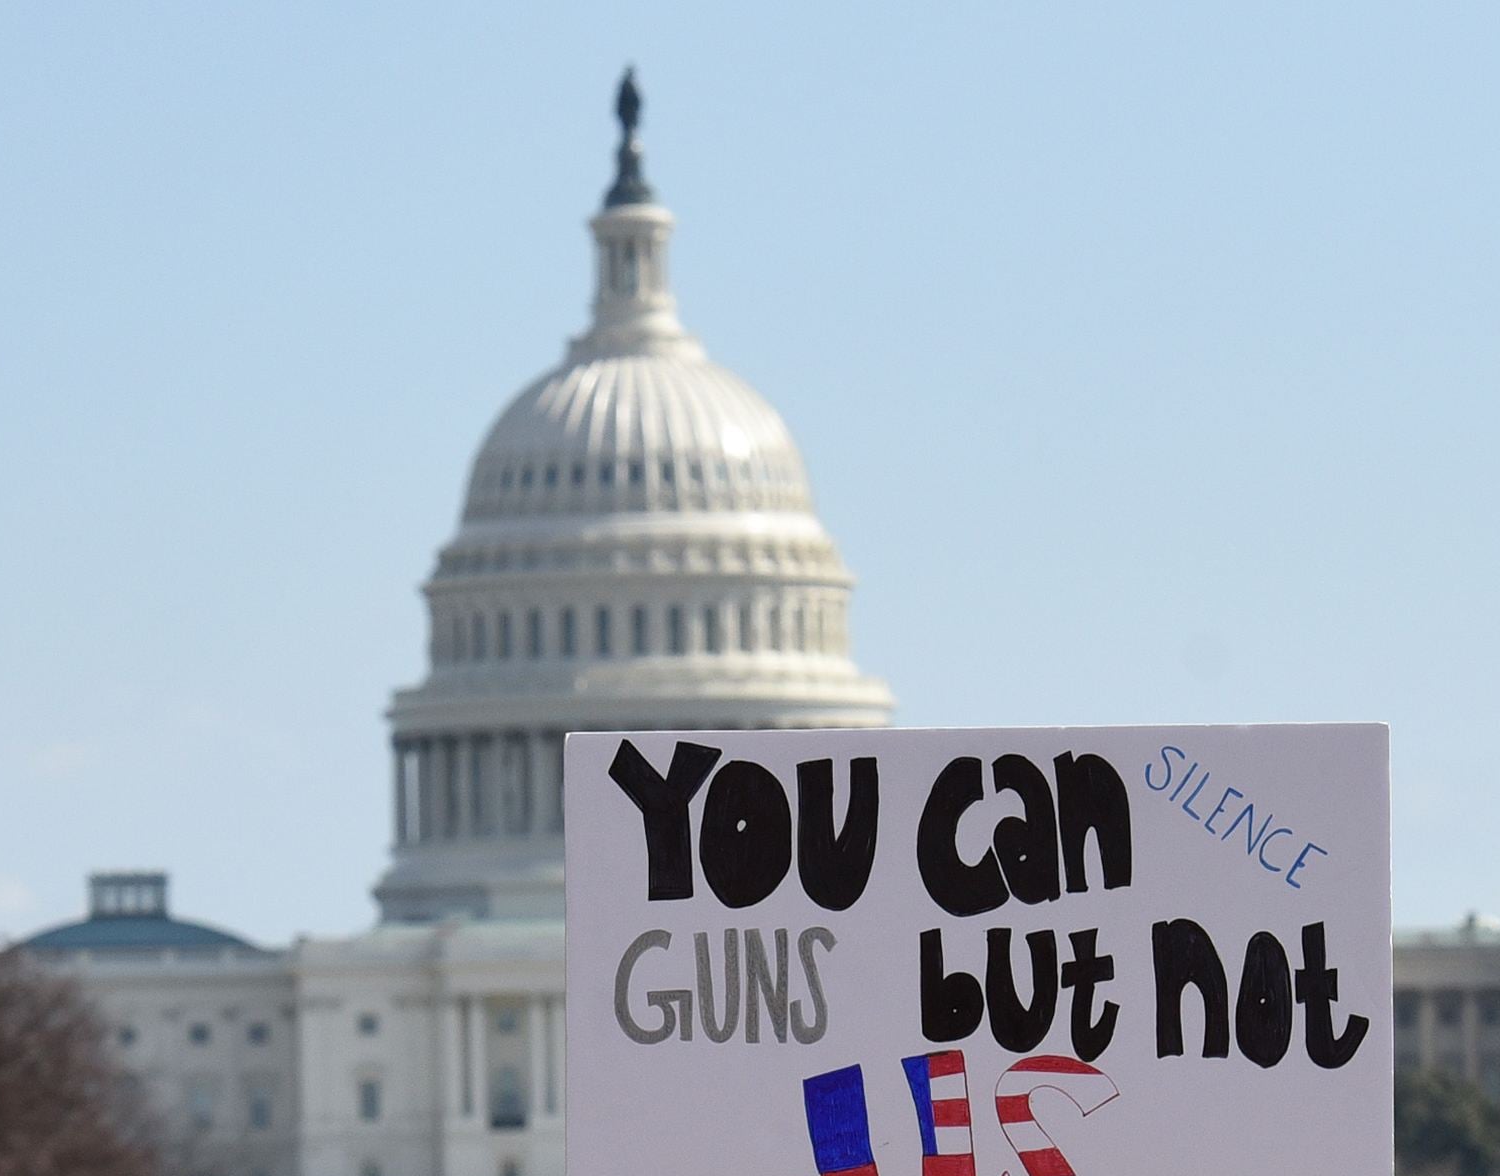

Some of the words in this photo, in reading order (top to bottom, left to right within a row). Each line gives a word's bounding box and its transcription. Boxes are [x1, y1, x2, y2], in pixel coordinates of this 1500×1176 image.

[607, 738, 880, 912] YOU
[916, 750, 1132, 916] can
[1143, 745, 1327, 890] SILENCE
[613, 927, 837, 1044] GUNS
[920, 927, 1118, 1062] but
[1152, 918, 1369, 1069] not
